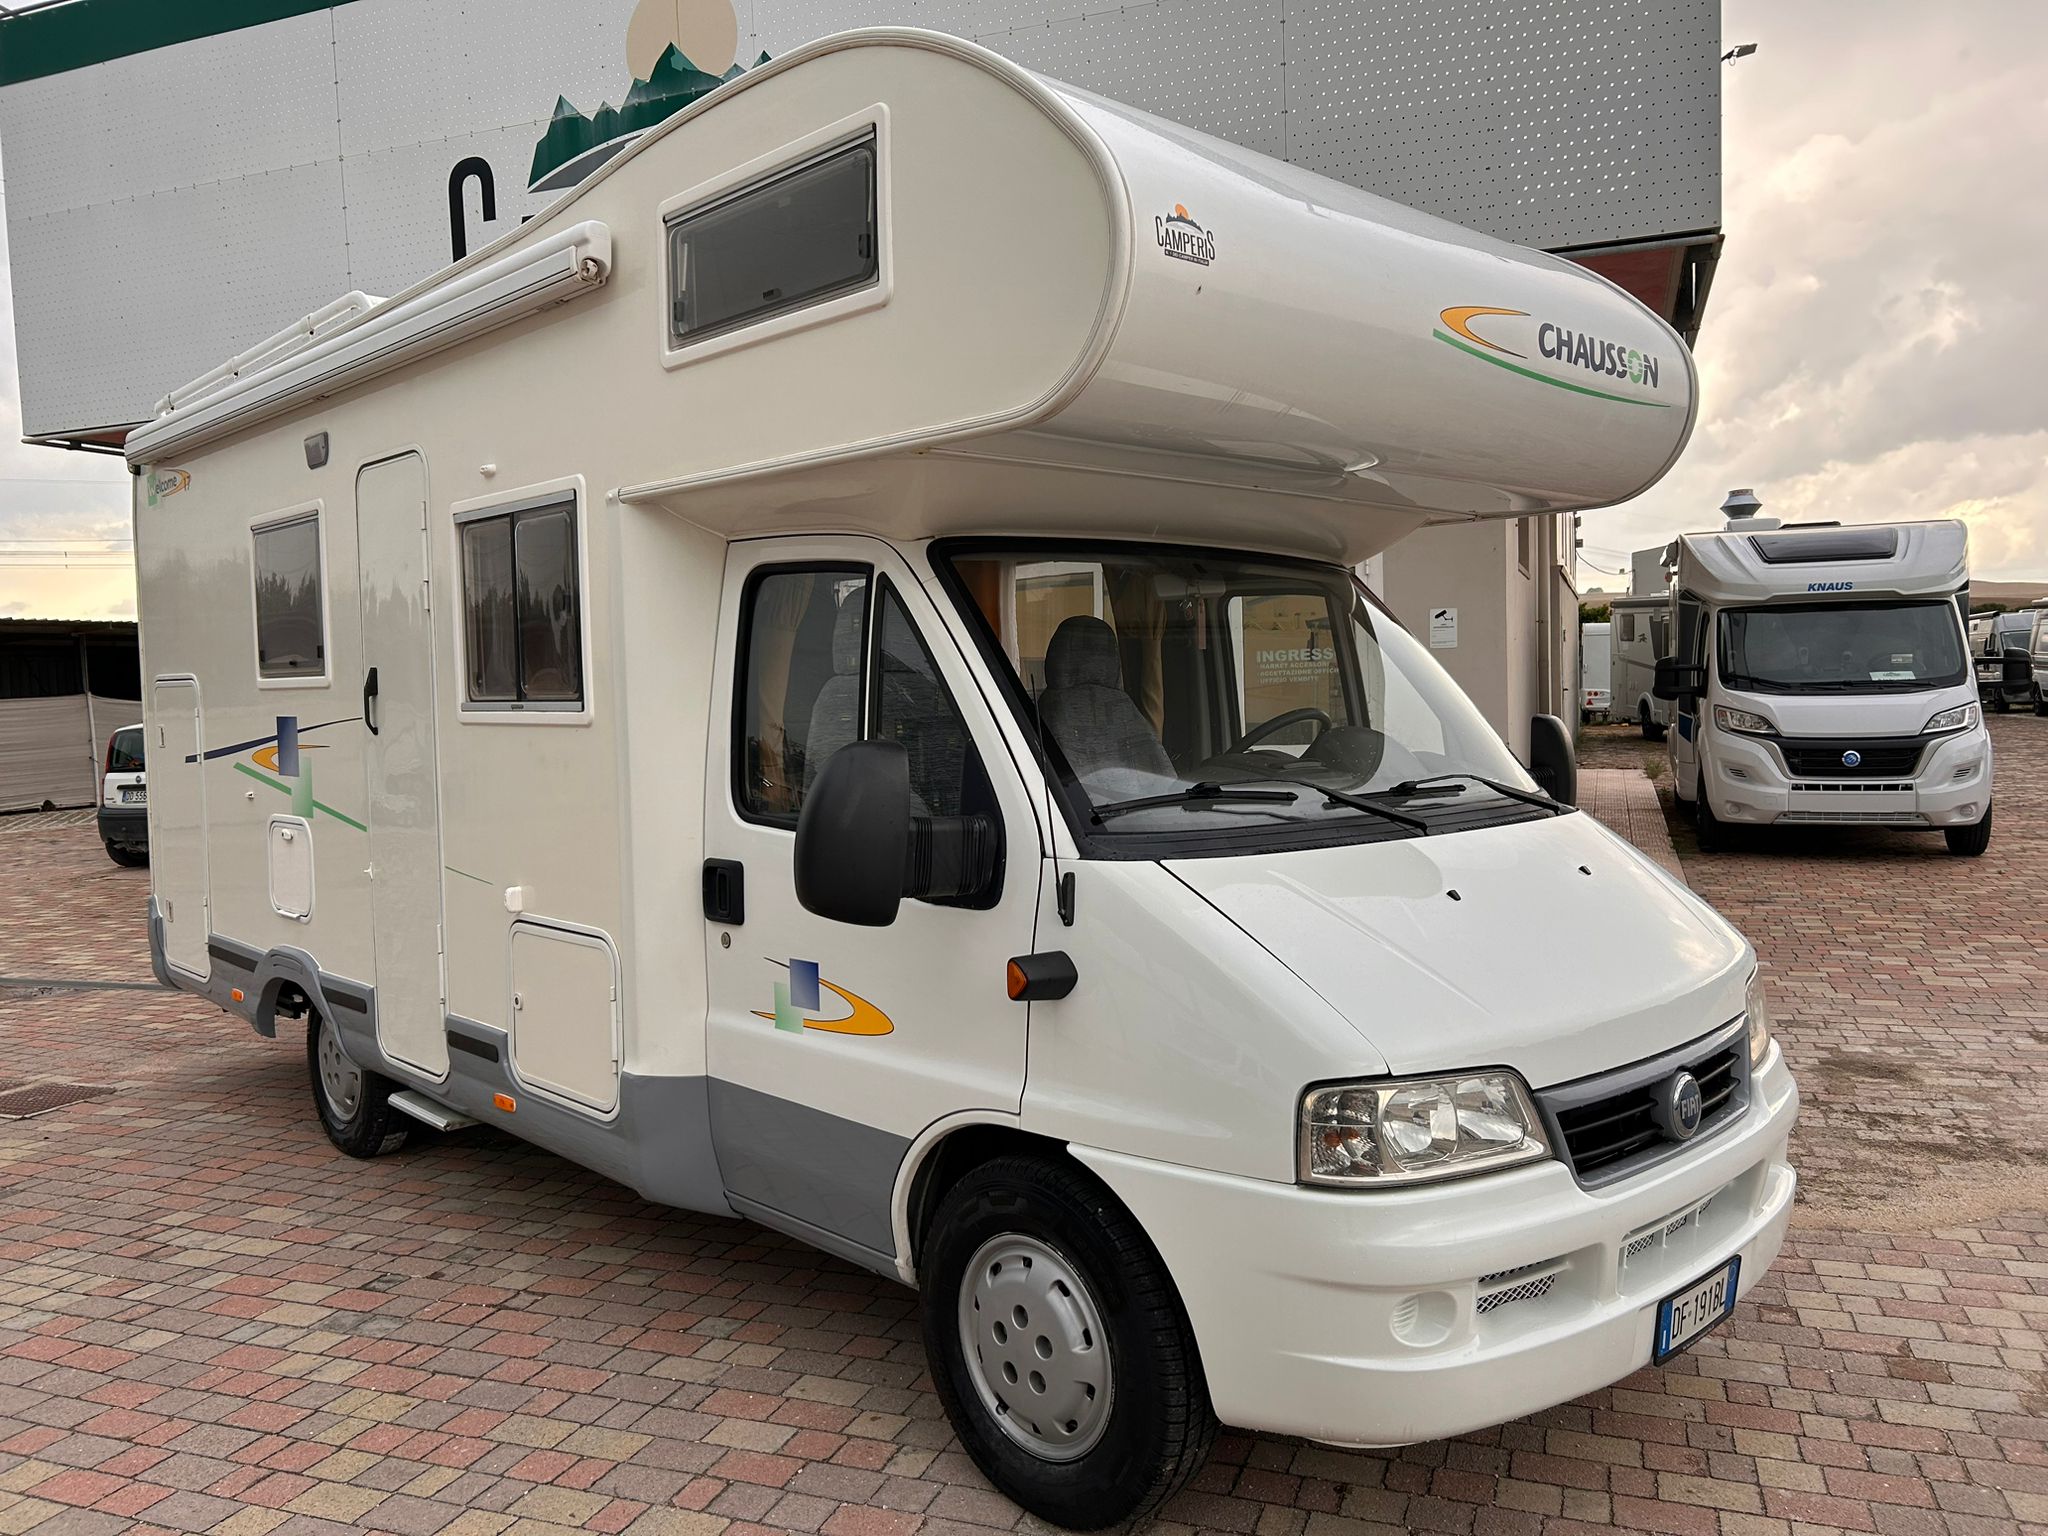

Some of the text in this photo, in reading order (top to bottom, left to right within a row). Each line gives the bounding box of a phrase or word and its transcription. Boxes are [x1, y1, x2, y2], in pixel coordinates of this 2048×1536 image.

[1155, 216, 1215, 260] CAMPERIS
[1538, 322, 1659, 388] CHAUSSON
[147, 475, 178, 496] Welcome
[1807, 581, 1853, 592] KNAUS
[1256, 647, 1336, 663] INGRESS
[1259, 662, 1288, 670] MARKET
[1681, 1094, 1700, 1120] FIAT
